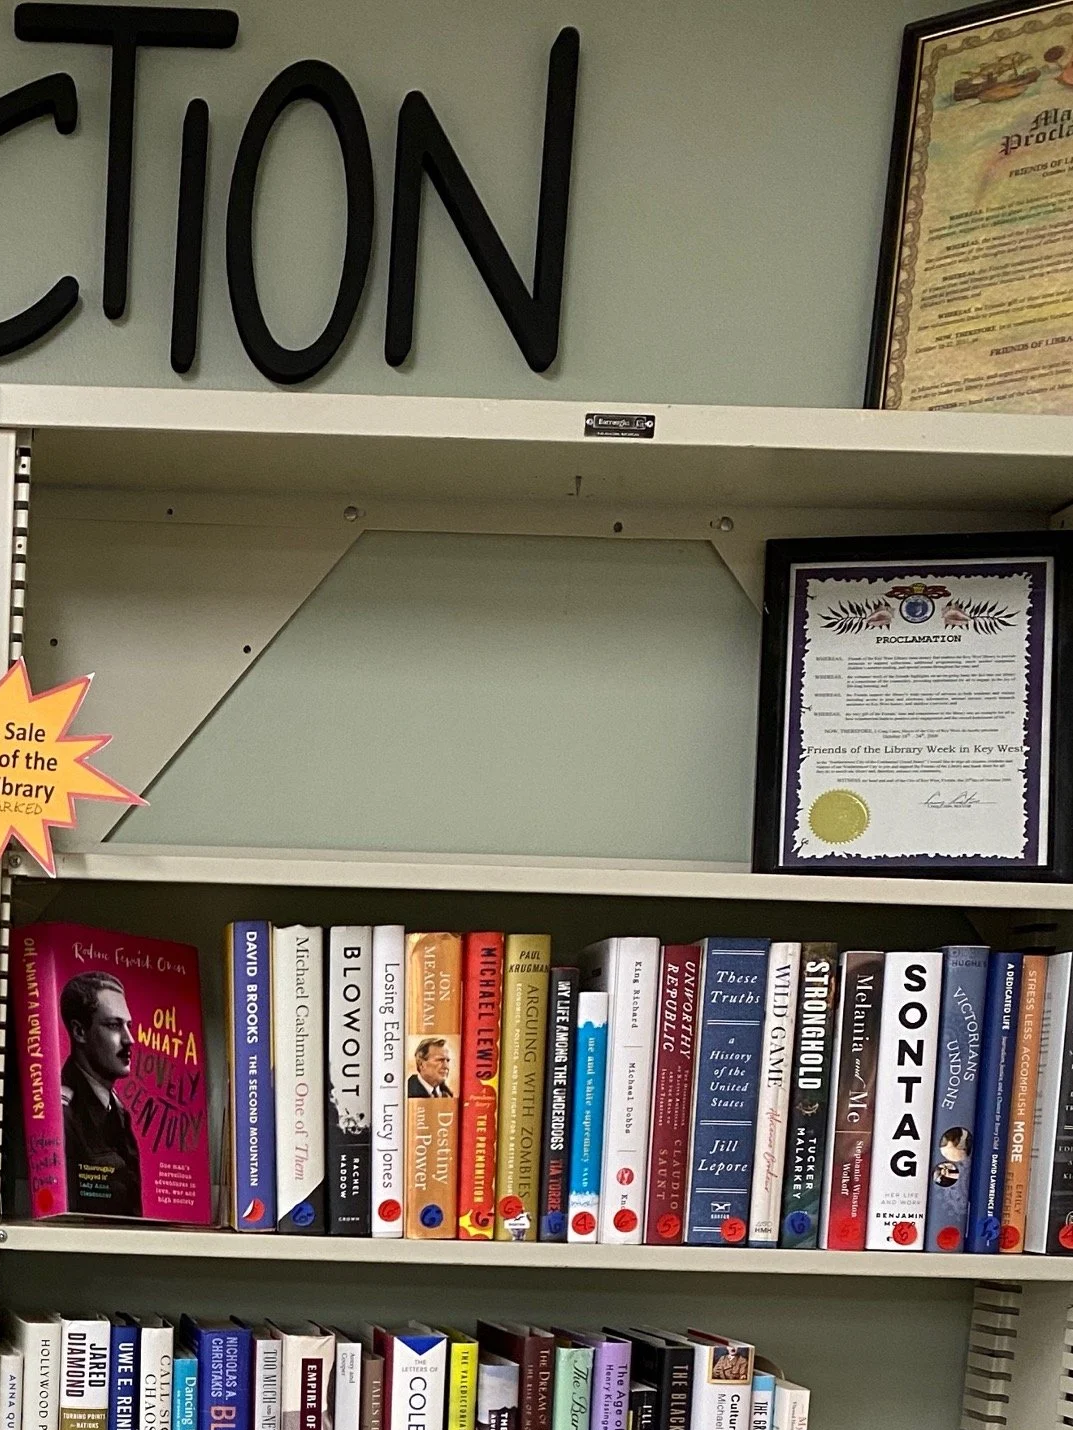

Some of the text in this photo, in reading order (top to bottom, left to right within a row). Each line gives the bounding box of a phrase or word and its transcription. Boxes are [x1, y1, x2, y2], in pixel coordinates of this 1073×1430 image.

[876, 635, 962, 645] PROCLAMATION
[5, 722, 46, 742] Sale
[807, 745, 1024, 756] Friends of the Library Week in Key West
[25, 752, 58, 771] the
[716, 971, 758, 984] These
[710, 990, 761, 1004] Truths
[342, 946, 361, 1097] BLOWOUT
[380, 963, 400, 1063] Losing Eden
[798, 961, 830, 1090] STRONGHOLD
[246, 931, 259, 1187] DAVID BROOKS THE SECOND MOUNTAIN
[890, 964, 928, 1177] SONTAG
[709, 1140, 738, 1154] Jill
[697, 1159, 748, 1174] Lepore
